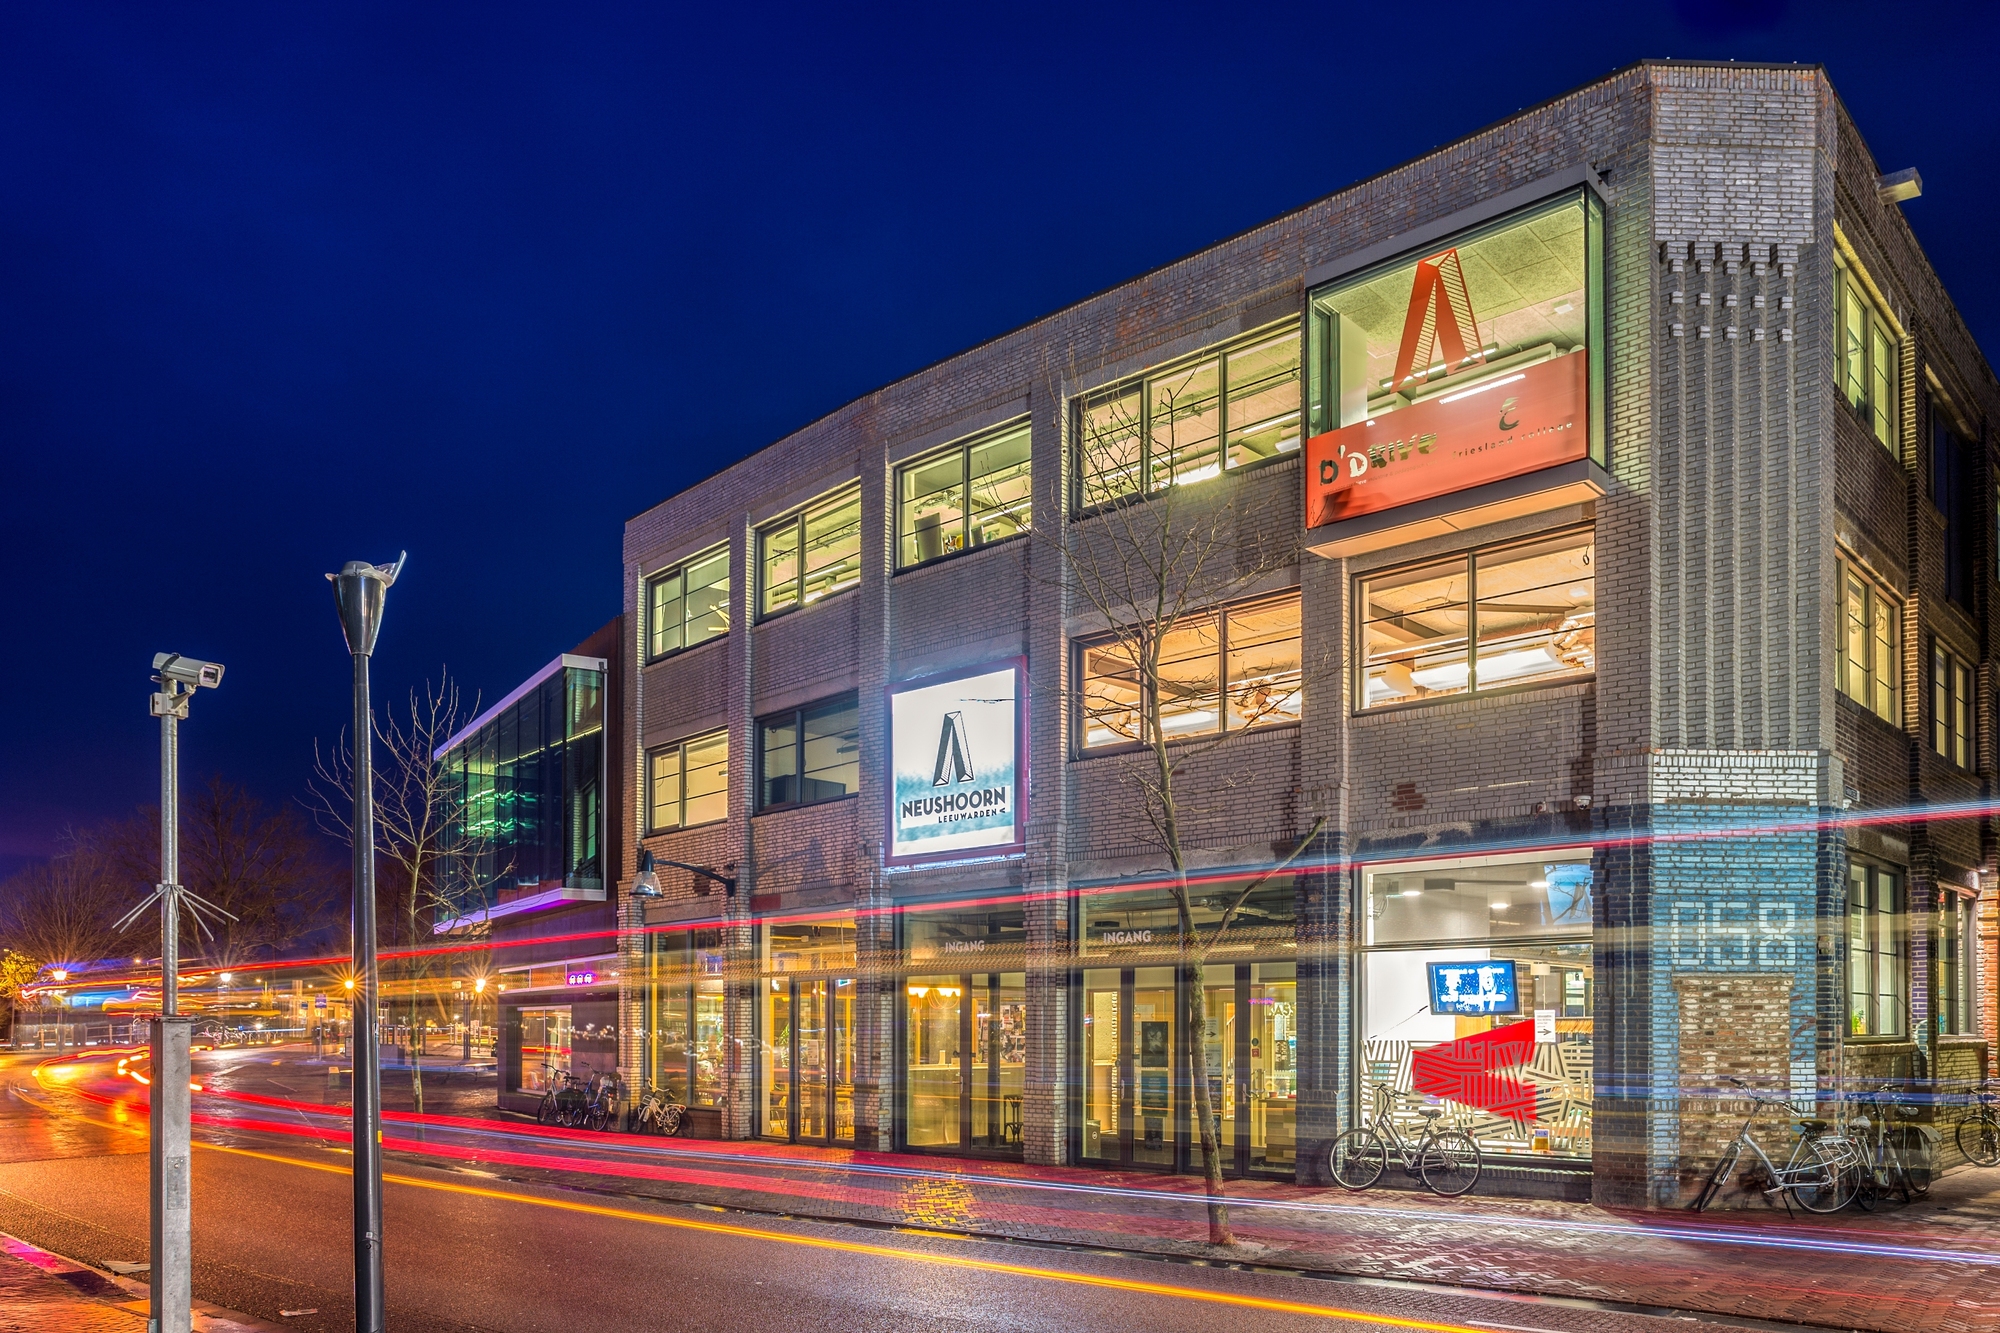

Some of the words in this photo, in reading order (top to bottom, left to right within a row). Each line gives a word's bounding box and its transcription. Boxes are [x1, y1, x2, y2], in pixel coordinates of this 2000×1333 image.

[902, 786, 1006, 819] NEUSHOORN
[938, 808, 997, 824] LEEUWARDEN
[1103, 929, 1151, 944] INGANG
[1671, 902, 1796, 965] 058
[945, 939, 985, 953] INGANG
